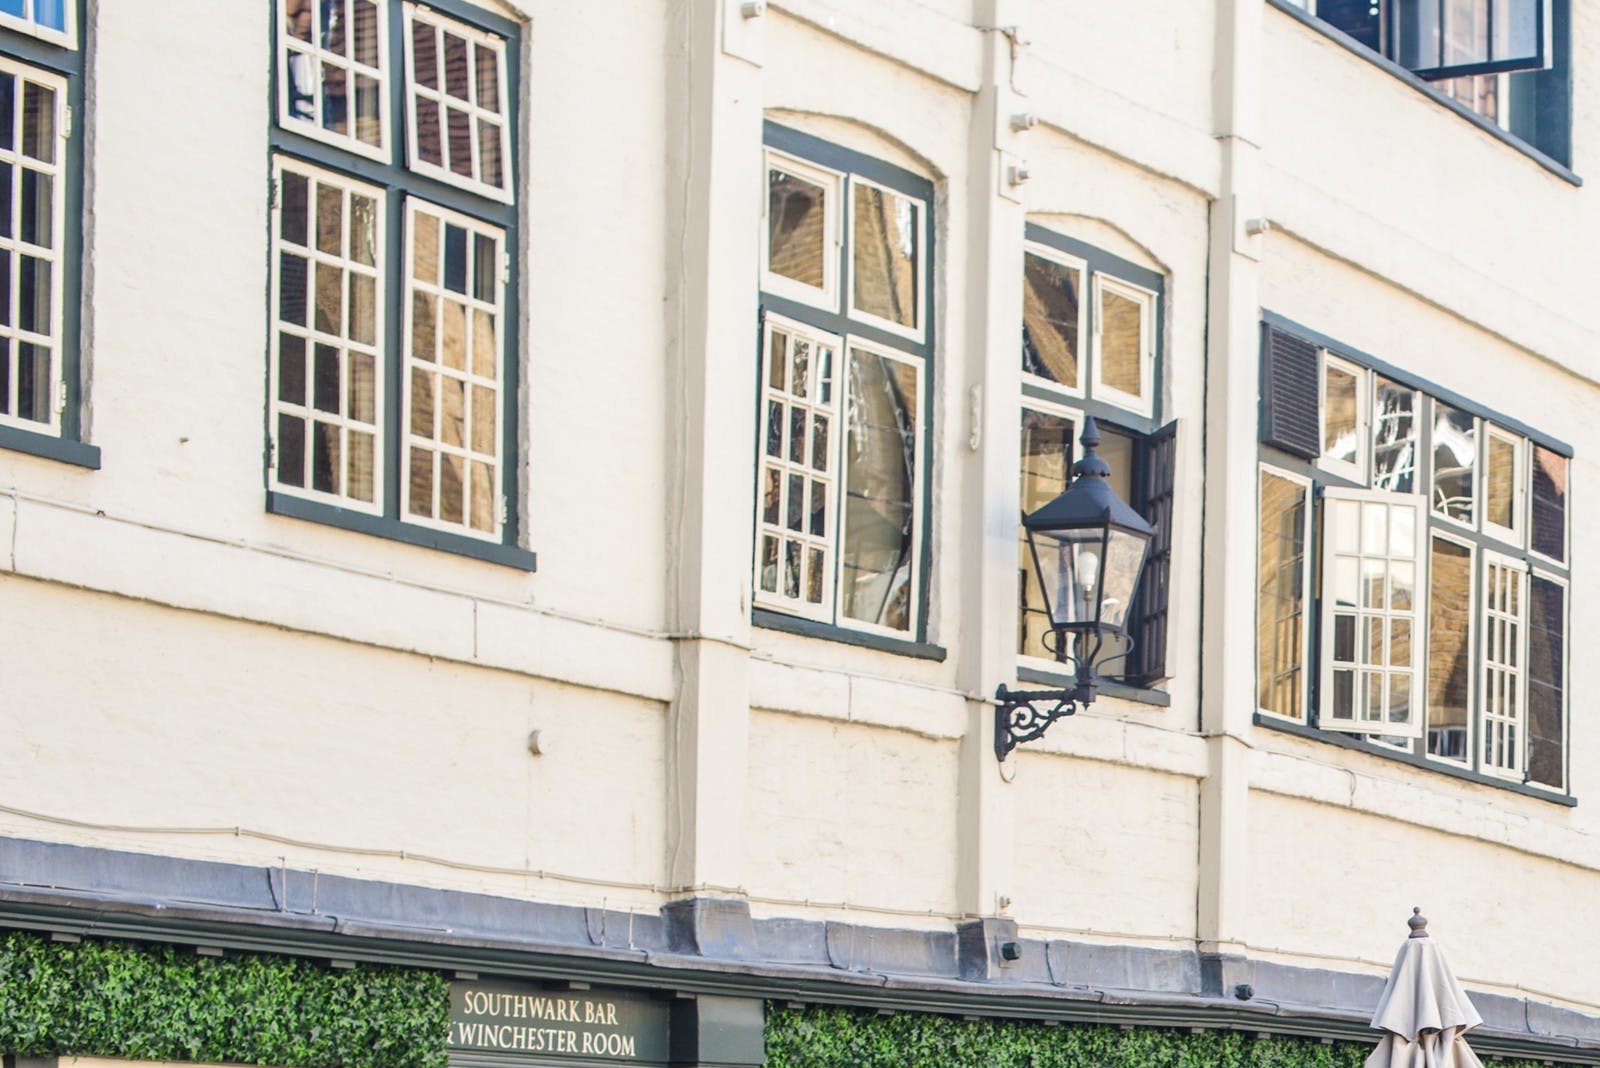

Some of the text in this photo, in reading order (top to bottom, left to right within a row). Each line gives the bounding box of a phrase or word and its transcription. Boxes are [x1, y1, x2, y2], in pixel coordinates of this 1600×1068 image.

[464, 990, 619, 1026] SOUTHWARK BAR
[458, 1022, 578, 1054] WINCHESTER
[582, 1033, 637, 1057] ROOM
